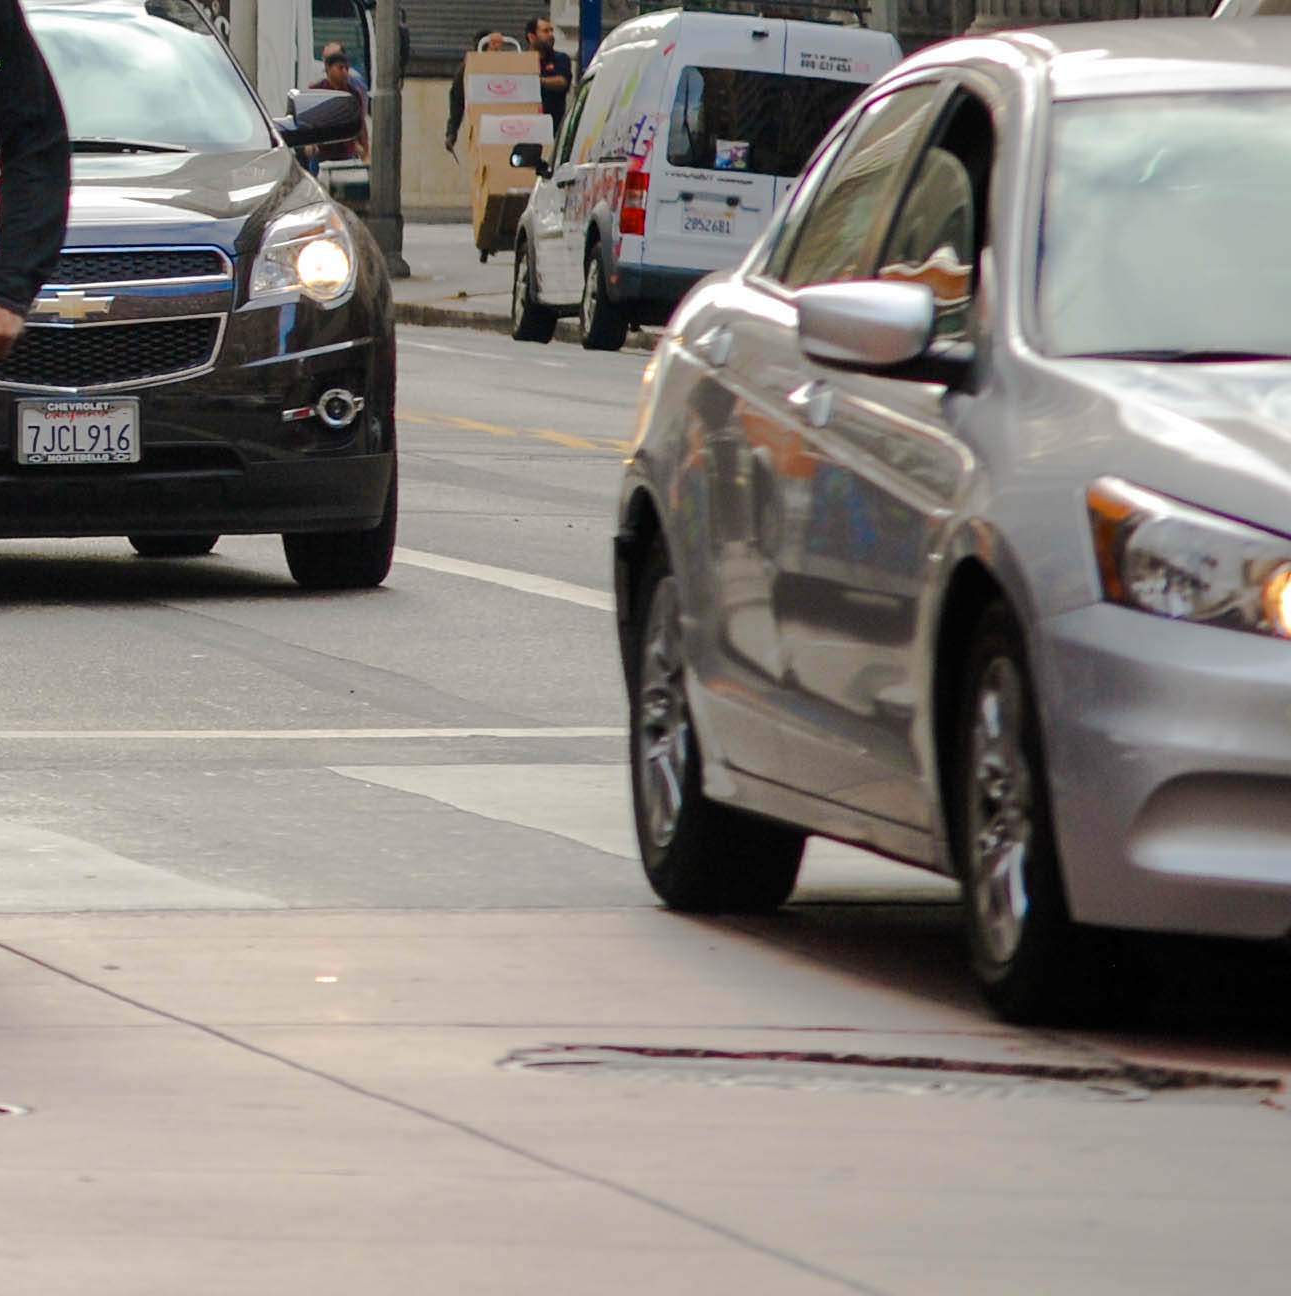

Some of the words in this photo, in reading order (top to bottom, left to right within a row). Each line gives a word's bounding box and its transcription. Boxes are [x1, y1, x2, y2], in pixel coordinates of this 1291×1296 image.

[47, 402, 110, 412] CHEVROLET
[27, 423, 131, 453] 7JCL916
[47, 453, 110, 463] MONTEBELLO
